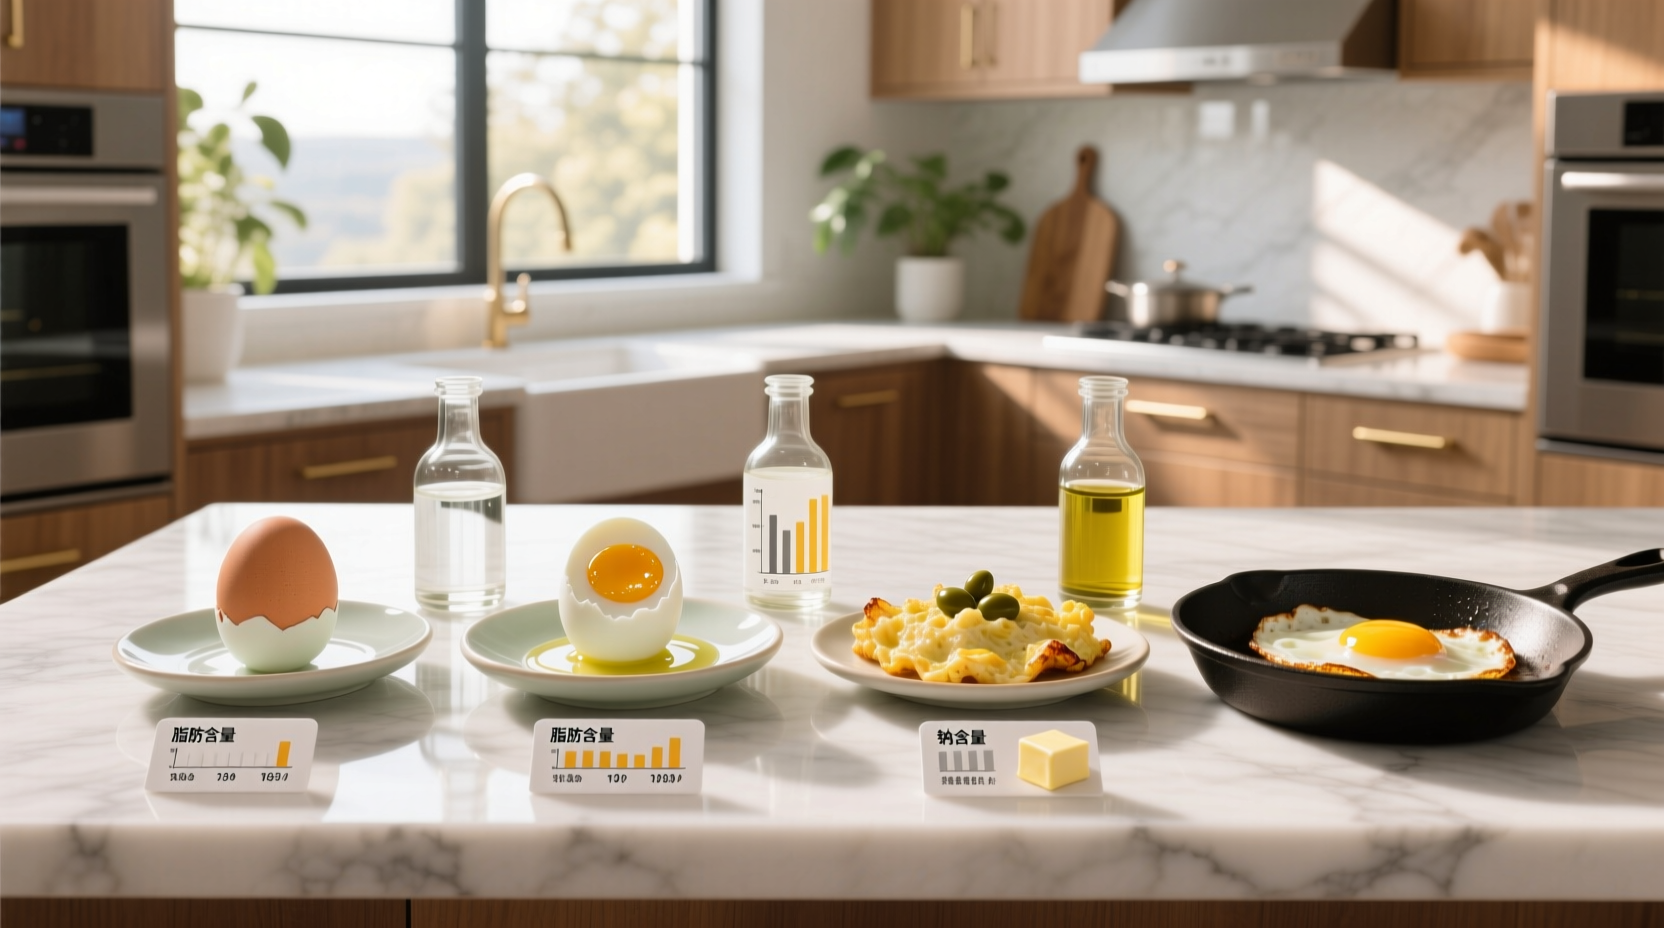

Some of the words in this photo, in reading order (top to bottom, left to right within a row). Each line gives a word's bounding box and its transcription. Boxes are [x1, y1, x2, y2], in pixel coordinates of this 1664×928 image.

[170, 726, 236, 744] 脂肪含量
[550, 727, 615, 744] 脂肪含量
